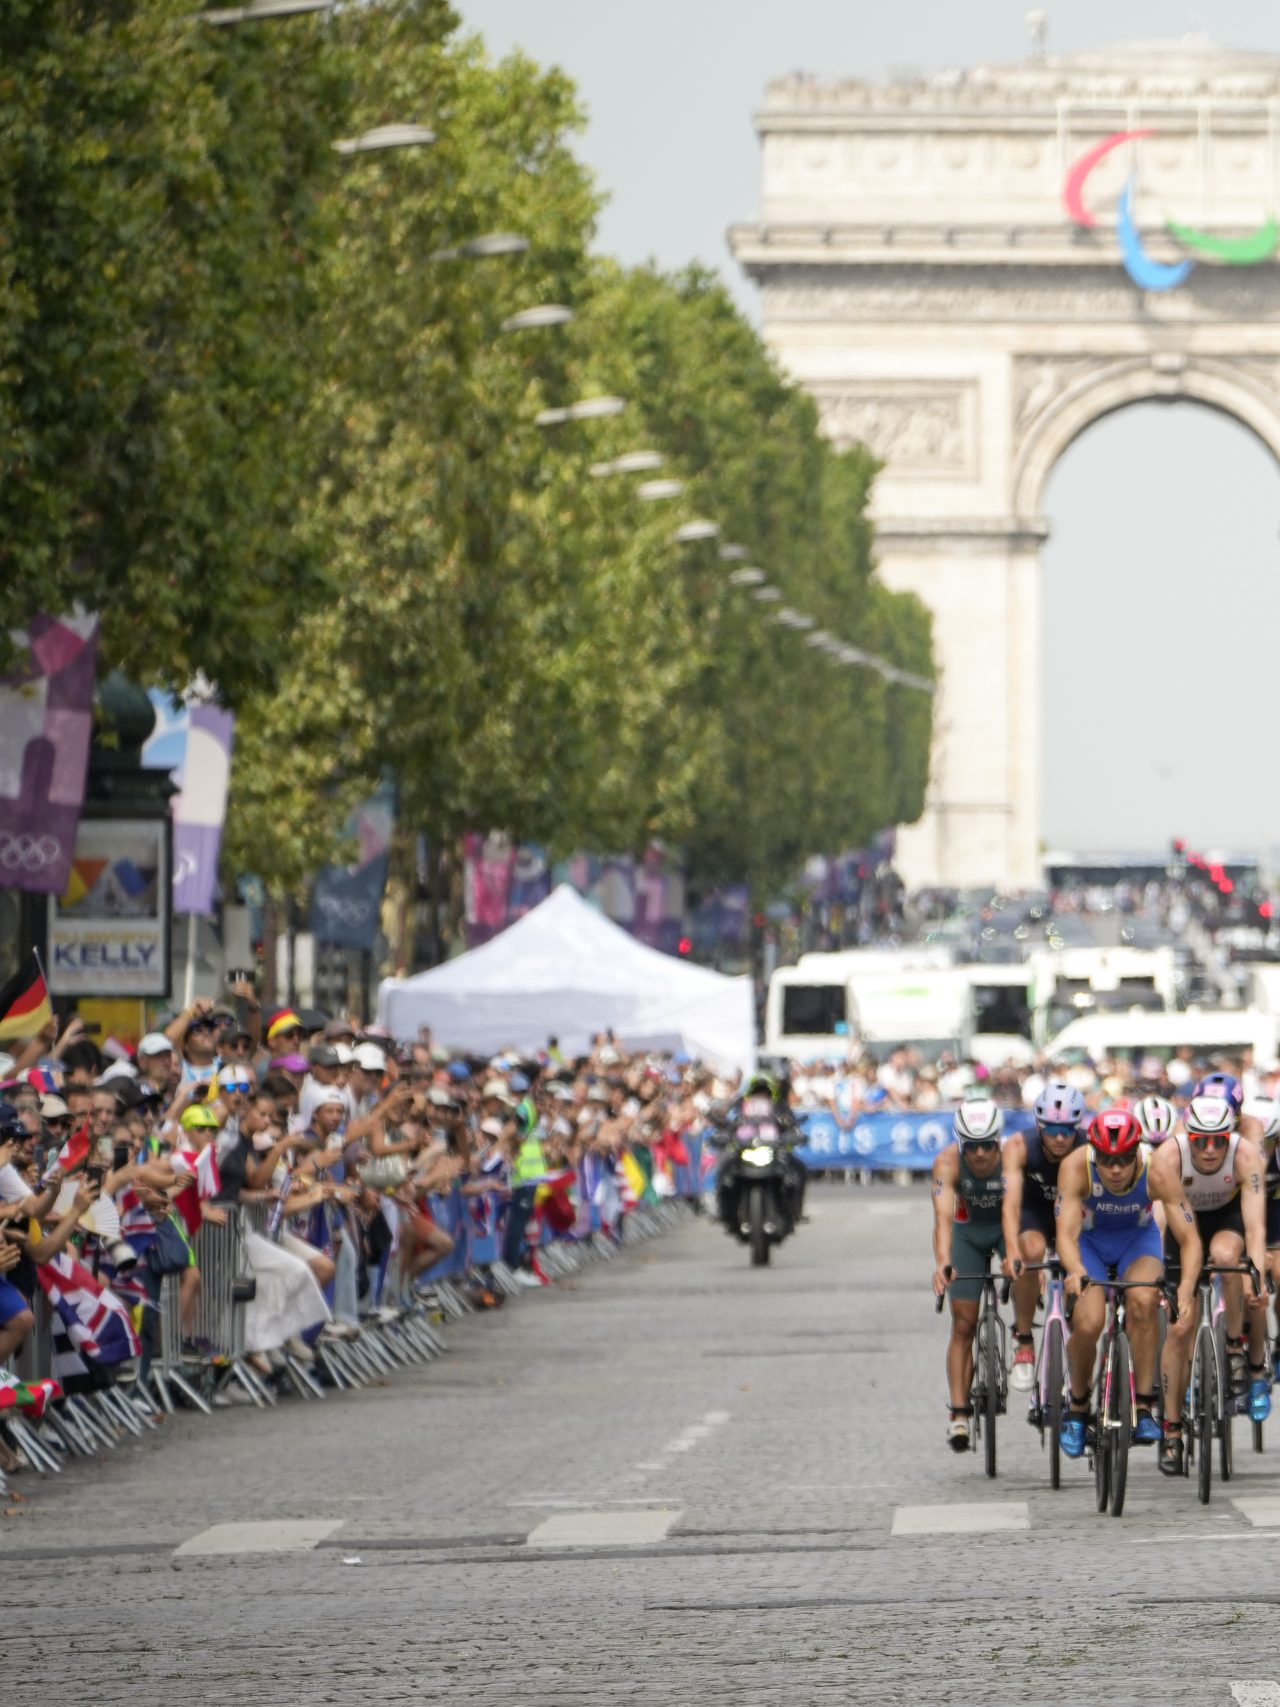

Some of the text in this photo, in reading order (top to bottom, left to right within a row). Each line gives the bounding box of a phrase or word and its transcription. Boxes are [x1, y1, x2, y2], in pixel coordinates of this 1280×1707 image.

[54, 943, 156, 968] KELLY
[809, 1123, 877, 1156] RIS
[1096, 1202, 1142, 1213] NENER
